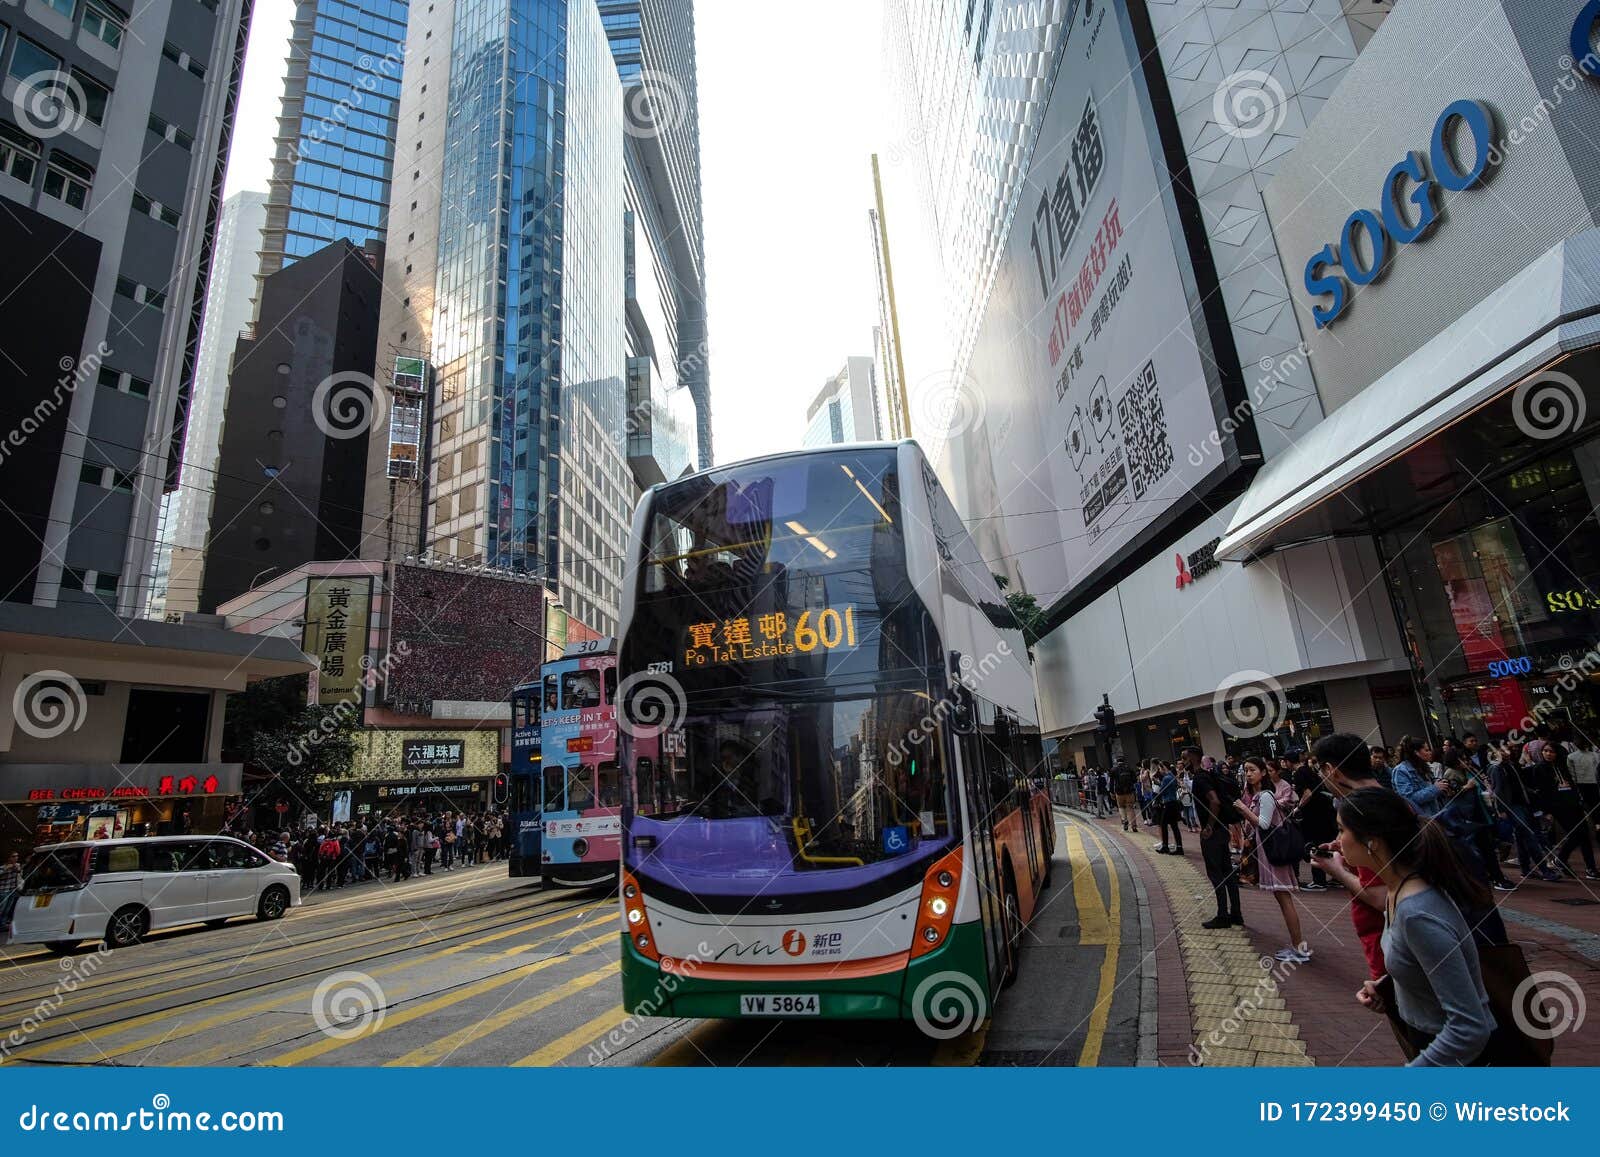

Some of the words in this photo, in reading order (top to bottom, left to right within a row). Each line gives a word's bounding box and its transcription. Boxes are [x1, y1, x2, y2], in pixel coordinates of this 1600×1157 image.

[1030, 96, 1104, 302] 17直播
[1304, 98, 1494, 330] SOGO
[321, 587, 350, 677] 黃金廣場
[688, 612, 787, 648] 寶達邨
[794, 607, 855, 651] 601
[578, 640, 598, 653] 30
[685, 649, 704, 665] Po
[712, 646, 737, 663] Tat
[743, 640, 794, 659] Estate
[647, 661, 673, 675] 5781
[1488, 656, 1531, 678] SOGO
[559, 715, 581, 724] KEEP
[408, 744, 460, 759] 六福珠寶
[29, 789, 54, 799] BEE
[61, 788, 106, 799] CHENG
[112, 787, 149, 797] HIANG
[813, 932, 842, 948] 新巴
[745, 997, 765, 1012] VW
[772, 997, 816, 1012] 5864
